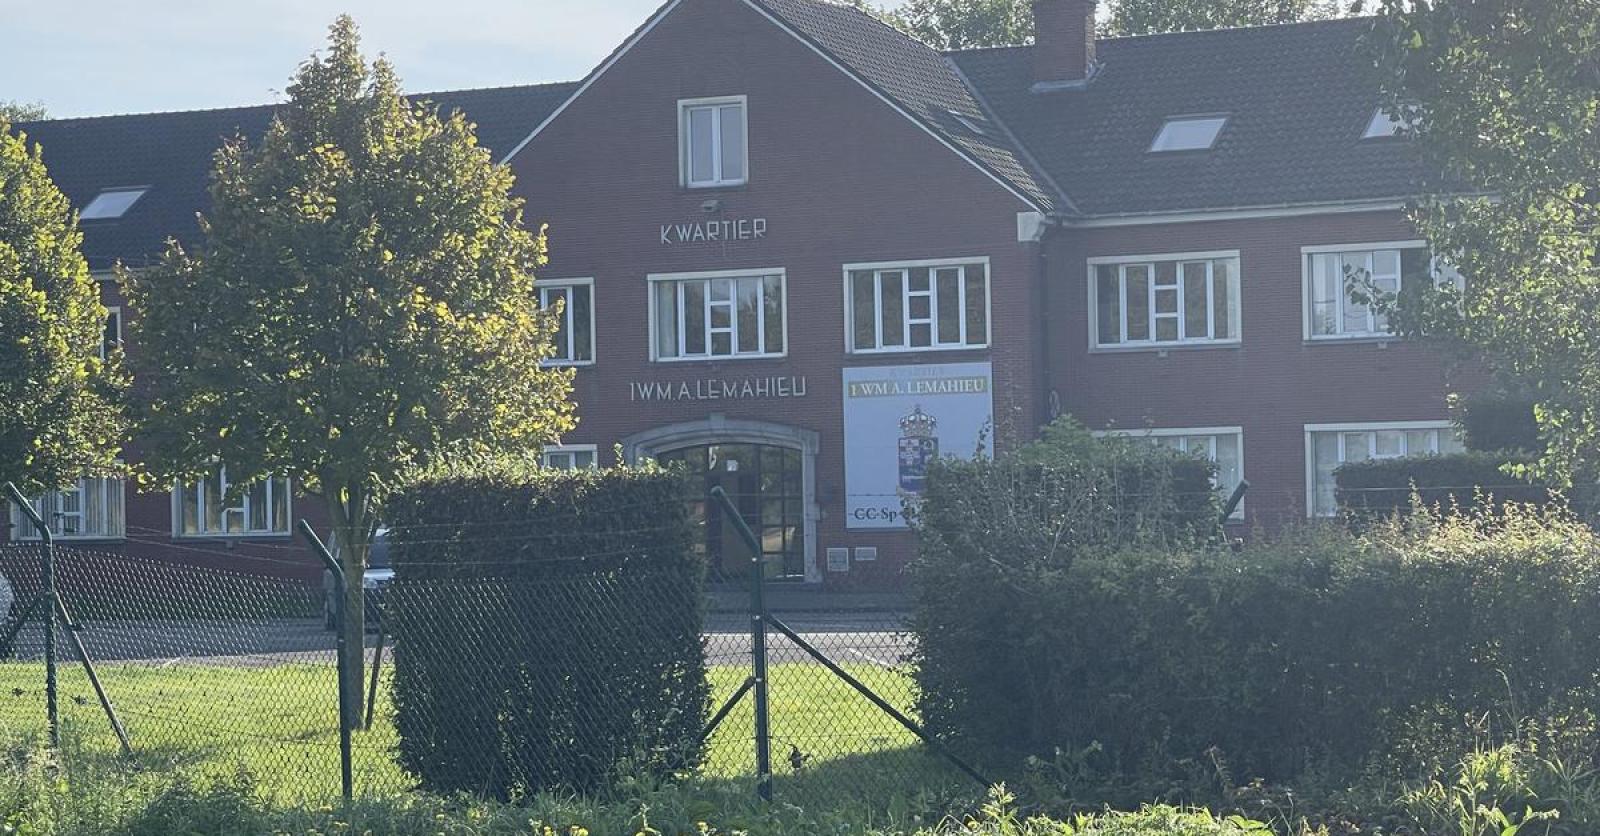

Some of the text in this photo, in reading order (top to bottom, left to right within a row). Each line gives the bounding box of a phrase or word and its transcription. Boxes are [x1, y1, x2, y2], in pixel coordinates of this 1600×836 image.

[660, 218, 766, 244] KWARTIER
[860, 382, 888, 395] WM
[907, 379, 984, 393] LEMAHIEU
